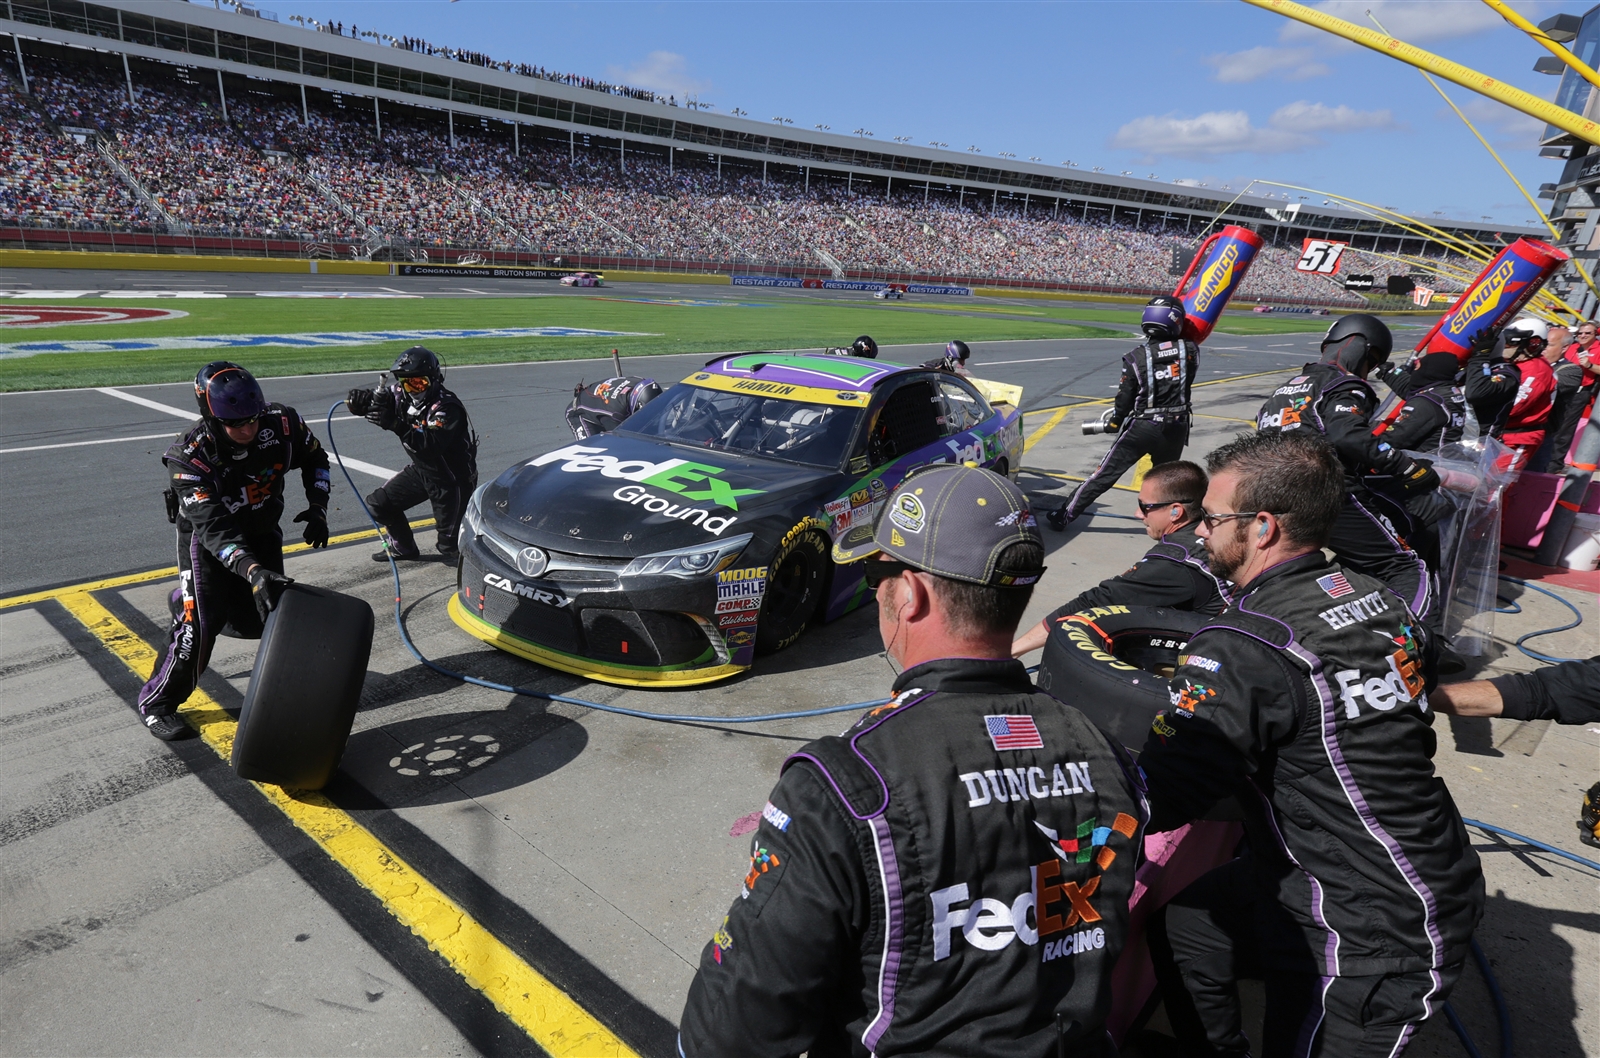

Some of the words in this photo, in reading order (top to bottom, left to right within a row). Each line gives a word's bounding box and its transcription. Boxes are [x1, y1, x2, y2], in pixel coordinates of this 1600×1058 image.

[1297, 239, 1346, 273] 51
[493, 269, 525, 277] BRUTON
[525, 270, 547, 278] SMITH
[734, 277, 776, 287] RESTART
[776, 279, 800, 288] ZONE
[1196, 247, 1237, 311] SUNOCO
[825, 281, 864, 291] RESTART
[909, 286, 952, 295] RESTART
[951, 288, 969, 296] ZONE
[1453, 263, 1511, 334] SUNOCO
[1157, 348, 1178, 358] HURD
[732, 380, 797, 396] HAMLIN
[257, 438, 280, 451] TOYOTA
[523, 444, 769, 512] FedEx
[613, 485, 738, 537] Ground
[836, 510, 852, 532] 3M
[718, 566, 768, 583] MOOG
[180, 569, 195, 623] FedEx
[483, 573, 574, 609] CAMRY
[718, 581, 765, 598] MAHLE
[717, 598, 752, 612] COMP
[1318, 590, 1390, 631] HEWITT
[719, 613, 758, 626] Edelbrock
[179, 623, 194, 661] RACING
[727, 632, 756, 643] SUNOCO
[959, 761, 1096, 808] DUNCAN
[929, 858, 1103, 962] FedEx
[1042, 927, 1106, 964] RACING
